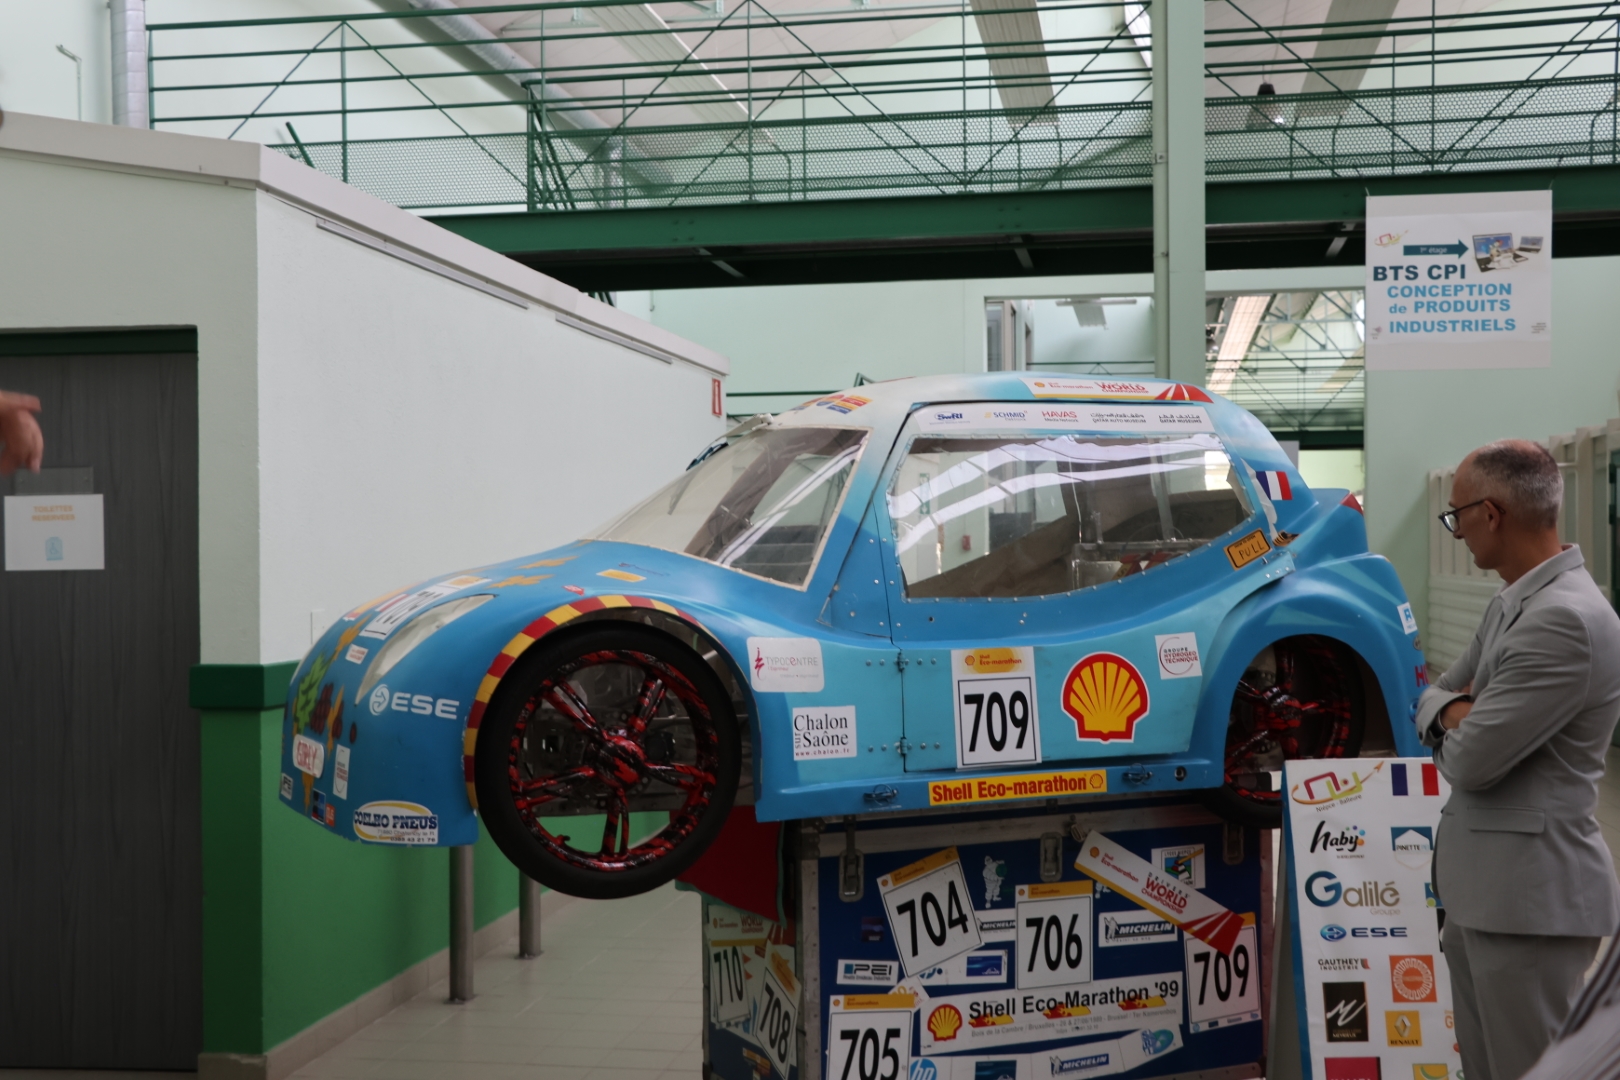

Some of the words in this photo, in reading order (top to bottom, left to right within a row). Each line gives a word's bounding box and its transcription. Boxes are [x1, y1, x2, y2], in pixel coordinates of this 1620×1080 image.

[1428, 246, 1447, 255] étage
[1373, 265, 1419, 281] BTS
[1427, 264, 1466, 280] CPI
[1387, 283, 1512, 298] CONCEPTION
[1389, 303, 1407, 314] de
[1414, 299, 1511, 313] PRODUITS
[1389, 318, 1516, 333] INDUSTRIELS
[1239, 540, 1264, 560] PULL
[1165, 656, 1198, 664] TECHNIQUE
[391, 692, 460, 719] ESE
[794, 713, 848, 732] Chalon
[963, 690, 1029, 752] 709
[803, 730, 849, 749] Saône
[795, 748, 850, 757] www.chalon.fr
[932, 782, 972, 803] Shell
[978, 774, 1087, 798] Eco-marathon
[1339, 794, 1362, 805] Balleure
[354, 811, 389, 828] COELHO
[392, 815, 437, 829] PNEUS
[1101, 857, 1139, 882] Eco-marathon
[1145, 877, 1188, 909] WORLD
[1304, 870, 1400, 908] Galilé
[1141, 888, 1184, 914] CHAMPIONSHIP
[896, 880, 969, 958] 704
[1370, 909, 1400, 917] Groupe
[1119, 923, 1173, 934] MICHELIN
[1351, 927, 1408, 938] ESE
[1026, 914, 1083, 972] 706
[854, 964, 892, 976] PEI
[1318, 958, 1360, 966] GAUTHEY
[713, 945, 744, 1006] 710
[1193, 944, 1250, 1005] 709
[969, 998, 1015, 1019] Shell
[1022, 986, 1149, 1014] Eco-Marathon
[1155, 980, 1179, 998] '99
[759, 981, 791, 1063] 708
[971, 1030, 985, 1038] Bois
[994, 1028, 1001, 1036] la
[1001, 1025, 1024, 1034] Cambre
[1028, 1021, 1055, 1031] Bruxelles
[840, 1027, 901, 1080] 705
[1062, 1056, 1107, 1070] MICHELIN
